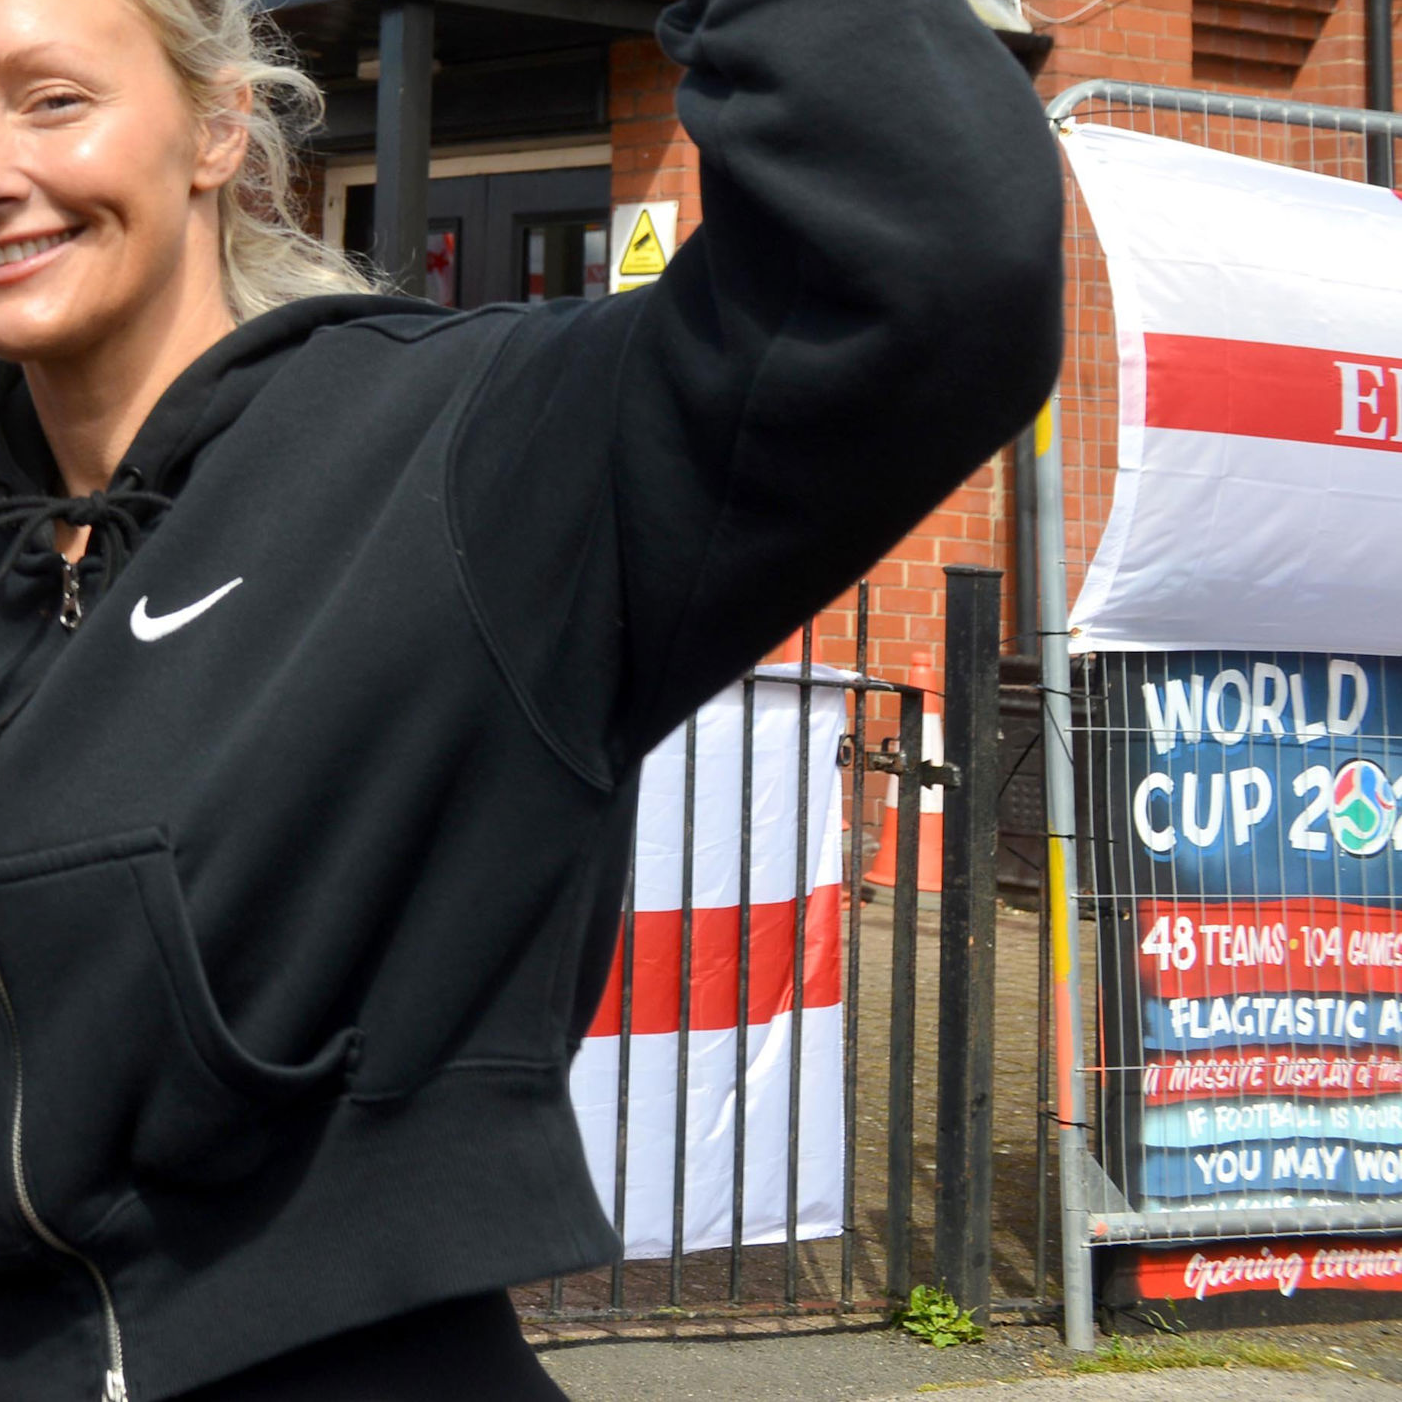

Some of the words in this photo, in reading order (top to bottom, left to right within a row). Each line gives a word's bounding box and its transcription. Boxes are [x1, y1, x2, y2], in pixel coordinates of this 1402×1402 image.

[1141, 659, 1369, 755] WORLD
[1134, 766, 1273, 851] CUP
[1141, 915, 1196, 970] 48
[1199, 922, 1288, 967] TEAMS
[1300, 926, 1342, 967] 104
[1169, 996, 1367, 1038] FLAGTASTIC
[1378, 999, 1402, 1035] A
[1168, 1056, 1266, 1091] MASSIVE
[1274, 1055, 1354, 1089] DISPLAY
[1187, 1107, 1208, 1139] IF
[1214, 1102, 1321, 1131] FOOTBALL
[1329, 1106, 1348, 1128] IS
[1194, 1149, 1262, 1184] YOU
[1273, 1146, 1345, 1180] MAY
[1353, 1149, 1402, 1183] WO
